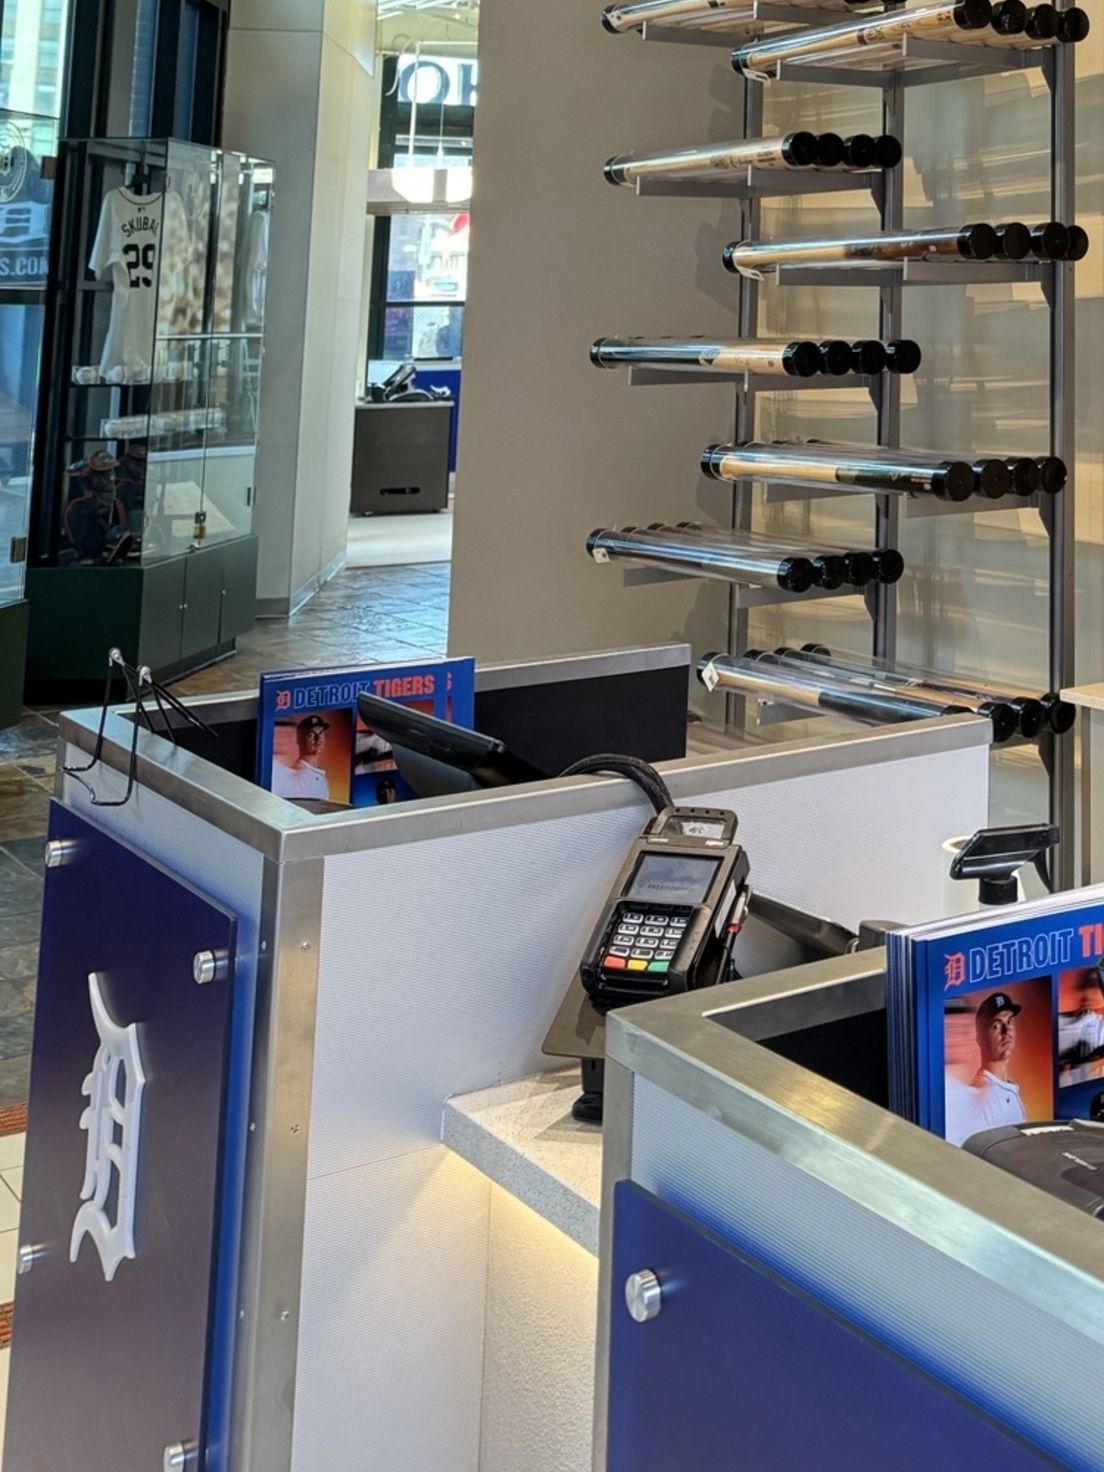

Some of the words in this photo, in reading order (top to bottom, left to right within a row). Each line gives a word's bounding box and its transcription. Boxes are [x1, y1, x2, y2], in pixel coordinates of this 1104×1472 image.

[122, 244, 156, 288] 29
[374, 674, 435, 698] TIGERS
[970, 929, 1074, 983] DETROIT
